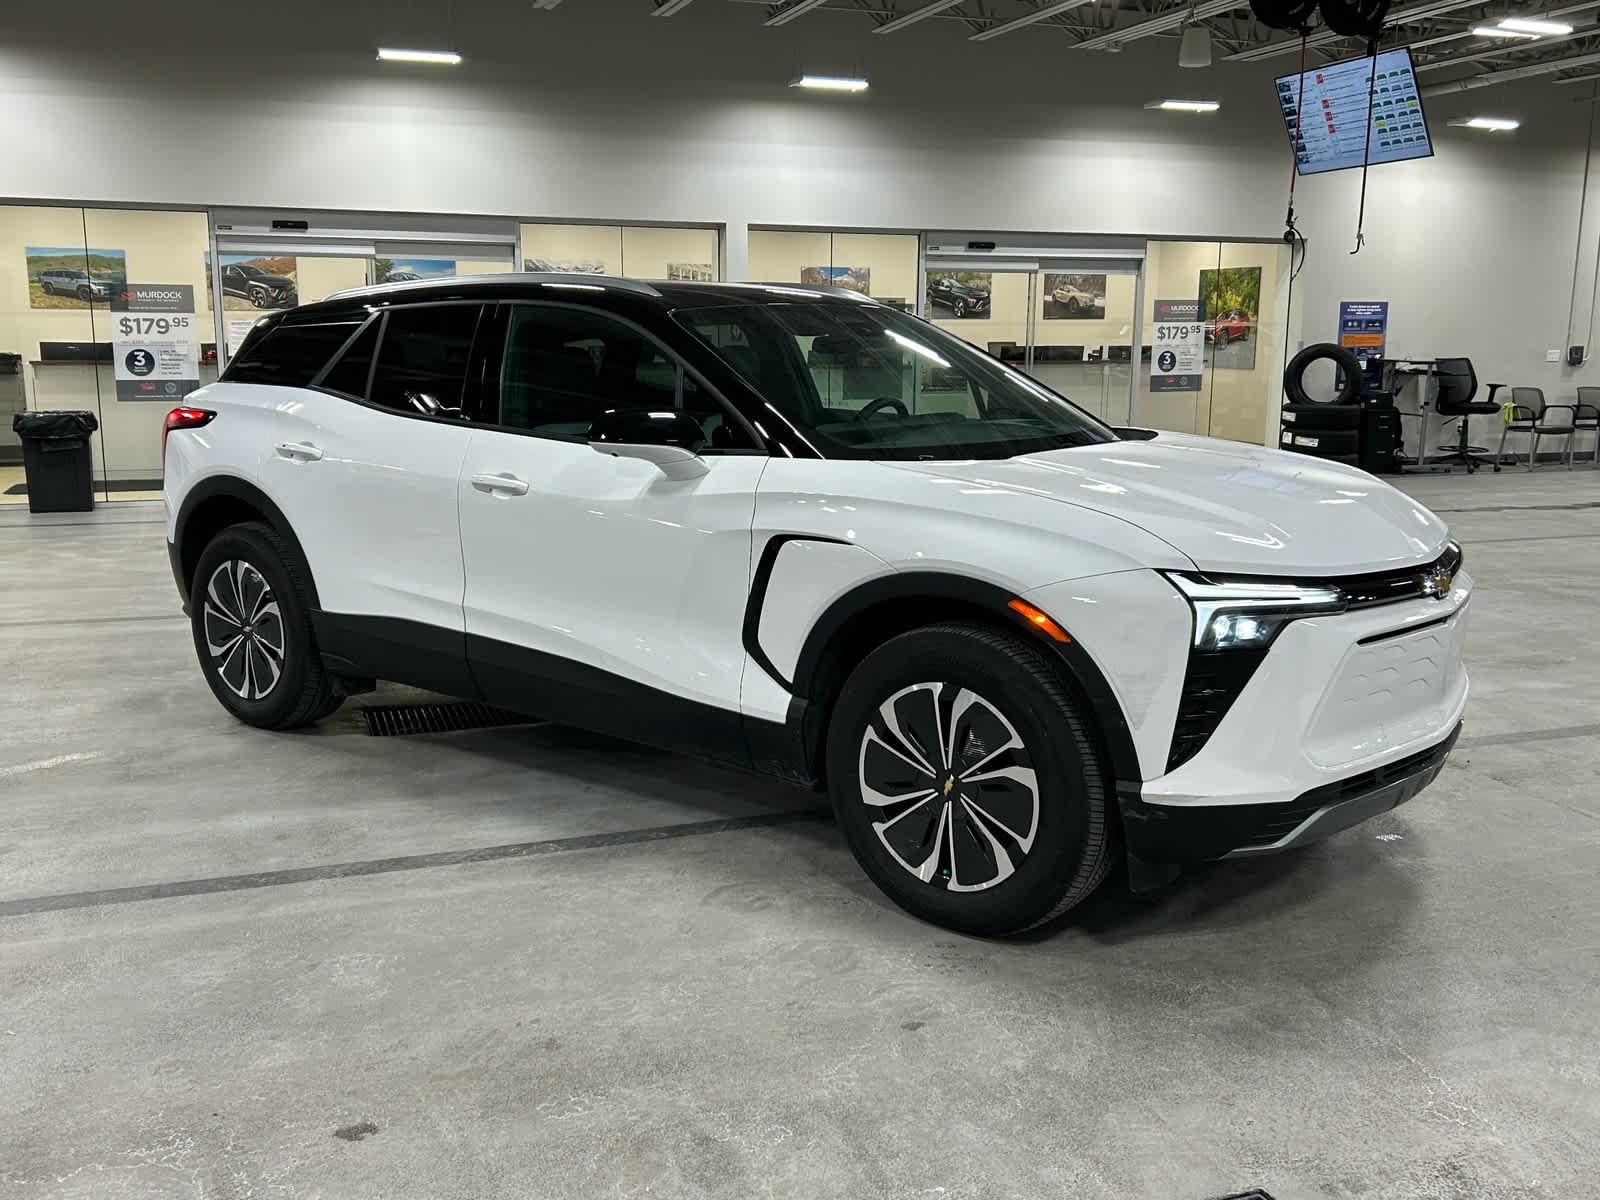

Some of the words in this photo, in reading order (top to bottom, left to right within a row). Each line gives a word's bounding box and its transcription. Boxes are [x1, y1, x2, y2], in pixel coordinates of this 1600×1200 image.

[136, 291, 182, 299] MURDOCK
[120, 316, 189, 336] $179.95
[1157, 325, 1201, 341] $179.95
[134, 351, 146, 366] 3
[1162, 352, 1171, 364] 3
